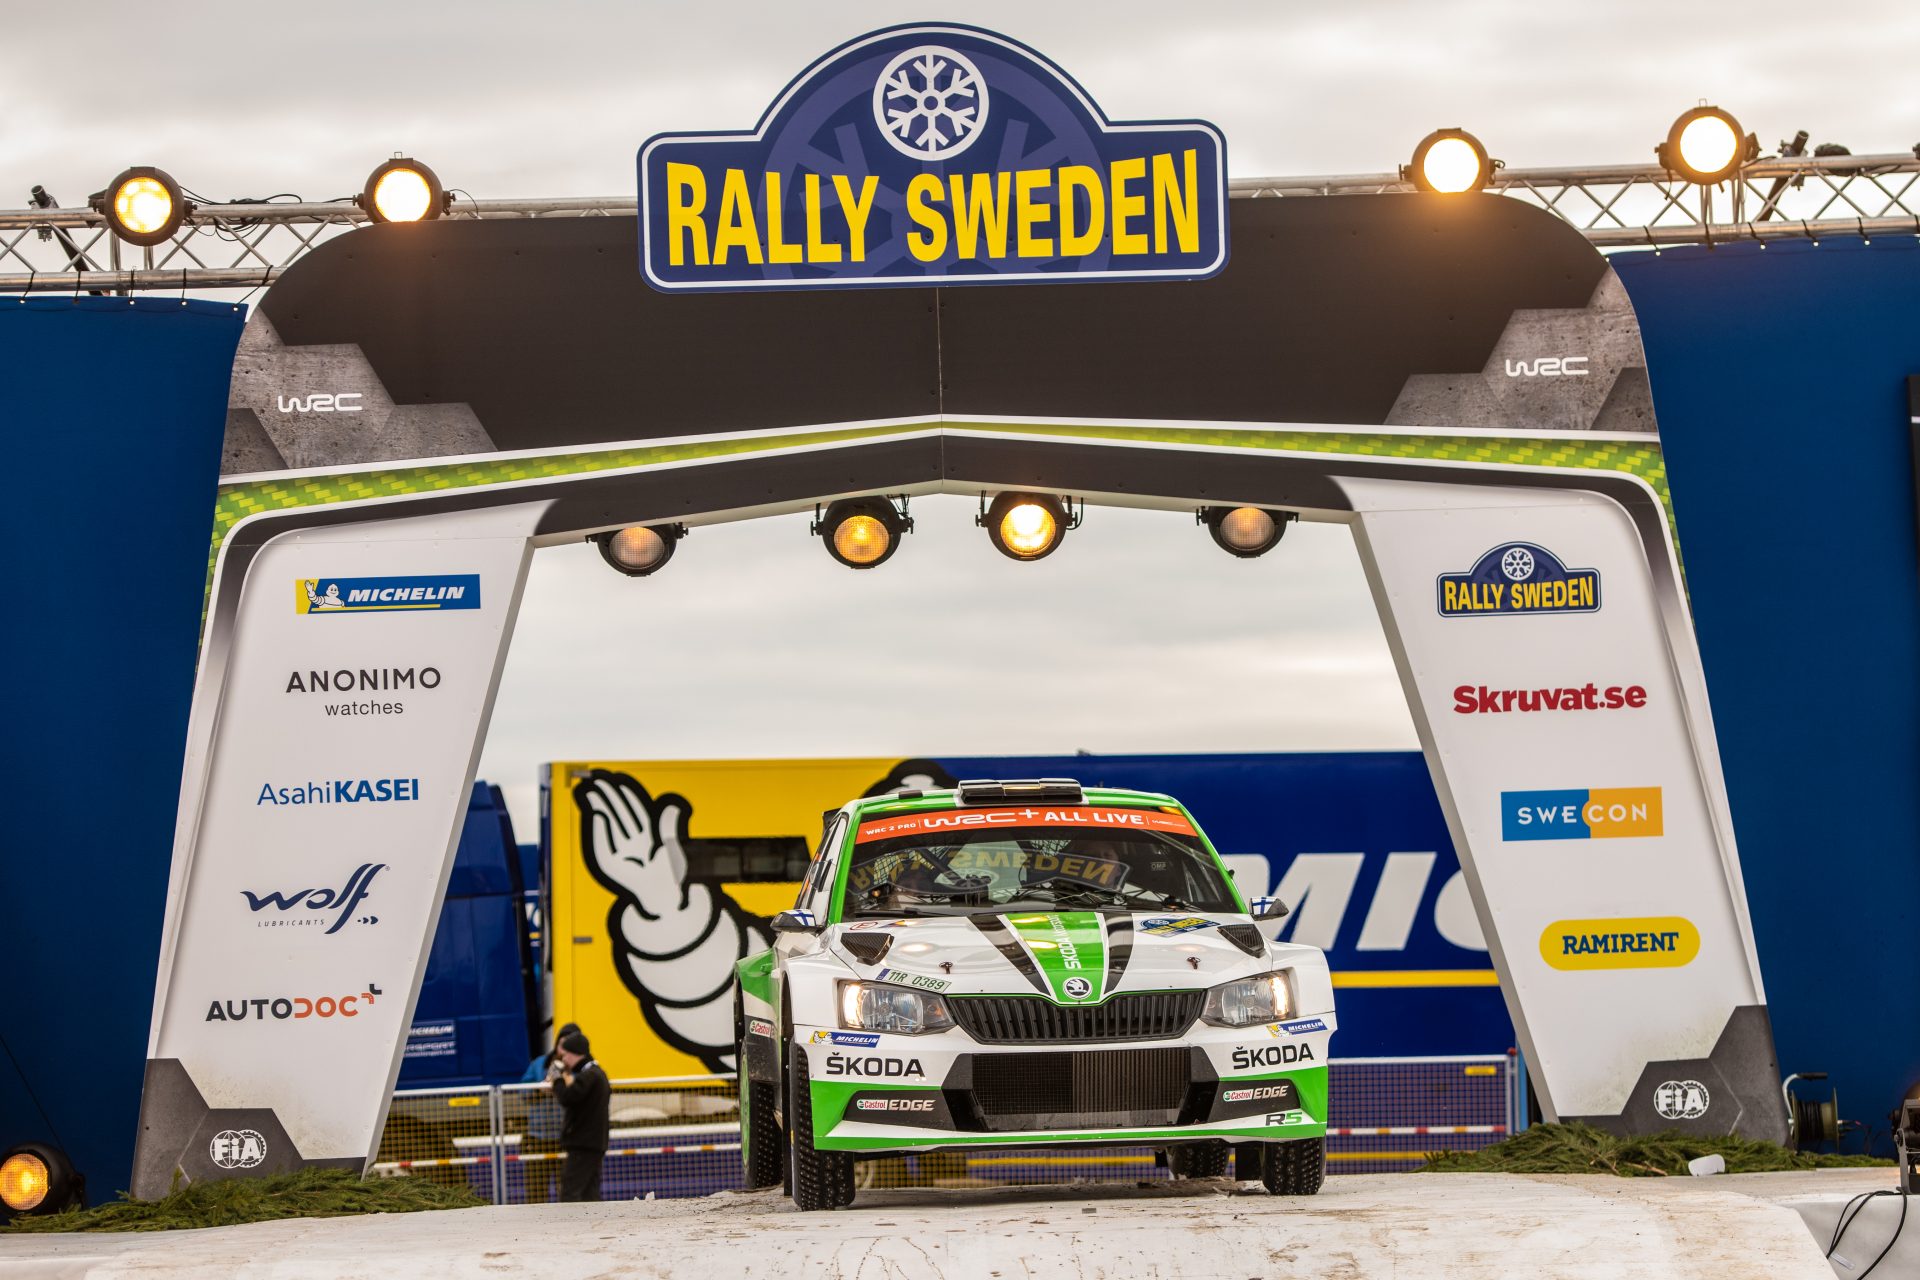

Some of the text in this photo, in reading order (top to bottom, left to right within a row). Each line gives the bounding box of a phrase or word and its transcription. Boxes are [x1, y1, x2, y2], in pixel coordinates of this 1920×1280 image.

[667, 149, 1200, 266] RALLY SWEDEN
[1506, 356, 1589, 377] WRC
[277, 393, 363, 413] WRC
[347, 585, 465, 603] MICHELIN
[1444, 576, 1594, 611] RALLY SWEDEN
[286, 667, 441, 694] ANONIMO
[325, 700, 404, 716] watches
[1453, 683, 1647, 714] Skruvat.se
[865, 827, 887, 835] WRC
[897, 822, 916, 830] PRO
[1044, 811, 1087, 821] ALL
[1093, 812, 1144, 825] LIVE
[258, 919, 325, 927] LUBRICANTS
[1562, 932, 1679, 955] RAMIRENT
[888, 971, 945, 990] 11R 0389
[206, 996, 359, 1021] AUTODOC
[1288, 1021, 1324, 1031] MICHELIN
[835, 1036, 879, 1044] MICHELIN
[826, 1052, 926, 1077] ŠKODA
[1231, 1043, 1314, 1070] ŠKODA
[1230, 1085, 1289, 1100] Castrol EDGE
[864, 1099, 936, 1111] Castrol EDGE
[1265, 1111, 1302, 1126] R5
